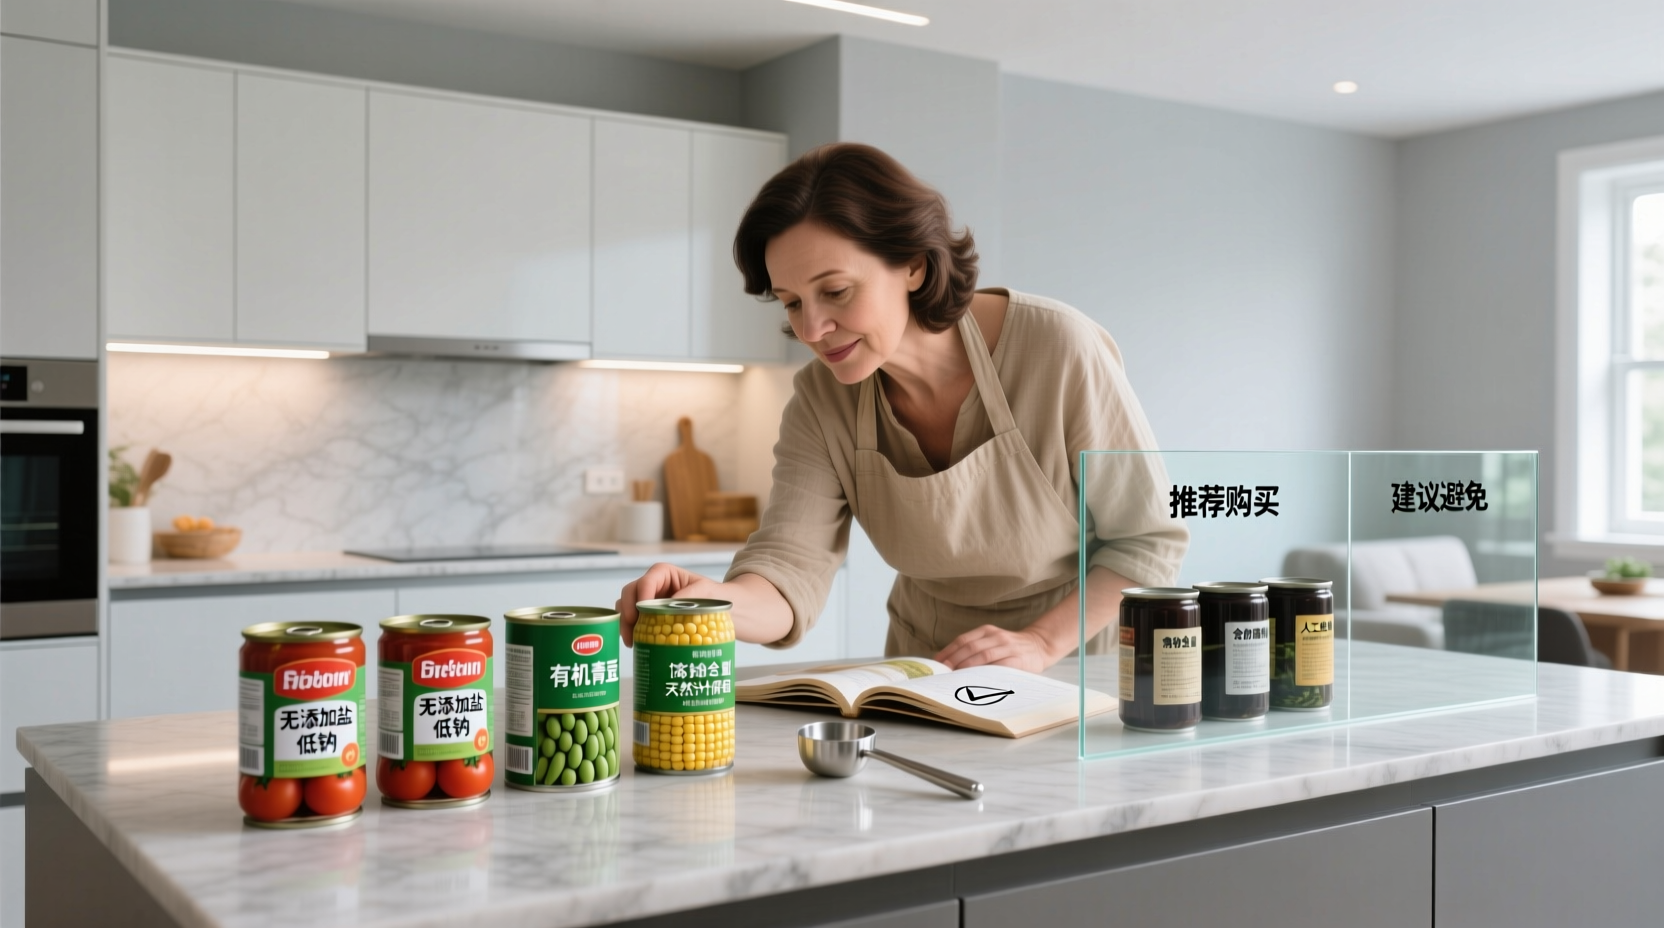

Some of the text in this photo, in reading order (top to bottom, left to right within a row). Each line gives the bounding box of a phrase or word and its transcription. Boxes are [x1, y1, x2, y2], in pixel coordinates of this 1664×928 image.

[1169, 484, 1280, 519] 推荐购买
[1391, 480, 1489, 514] 建议避免
[550, 659, 619, 688] 有机青豆
[280, 705, 353, 731] 无添加盐
[419, 692, 484, 716] 无添加盐
